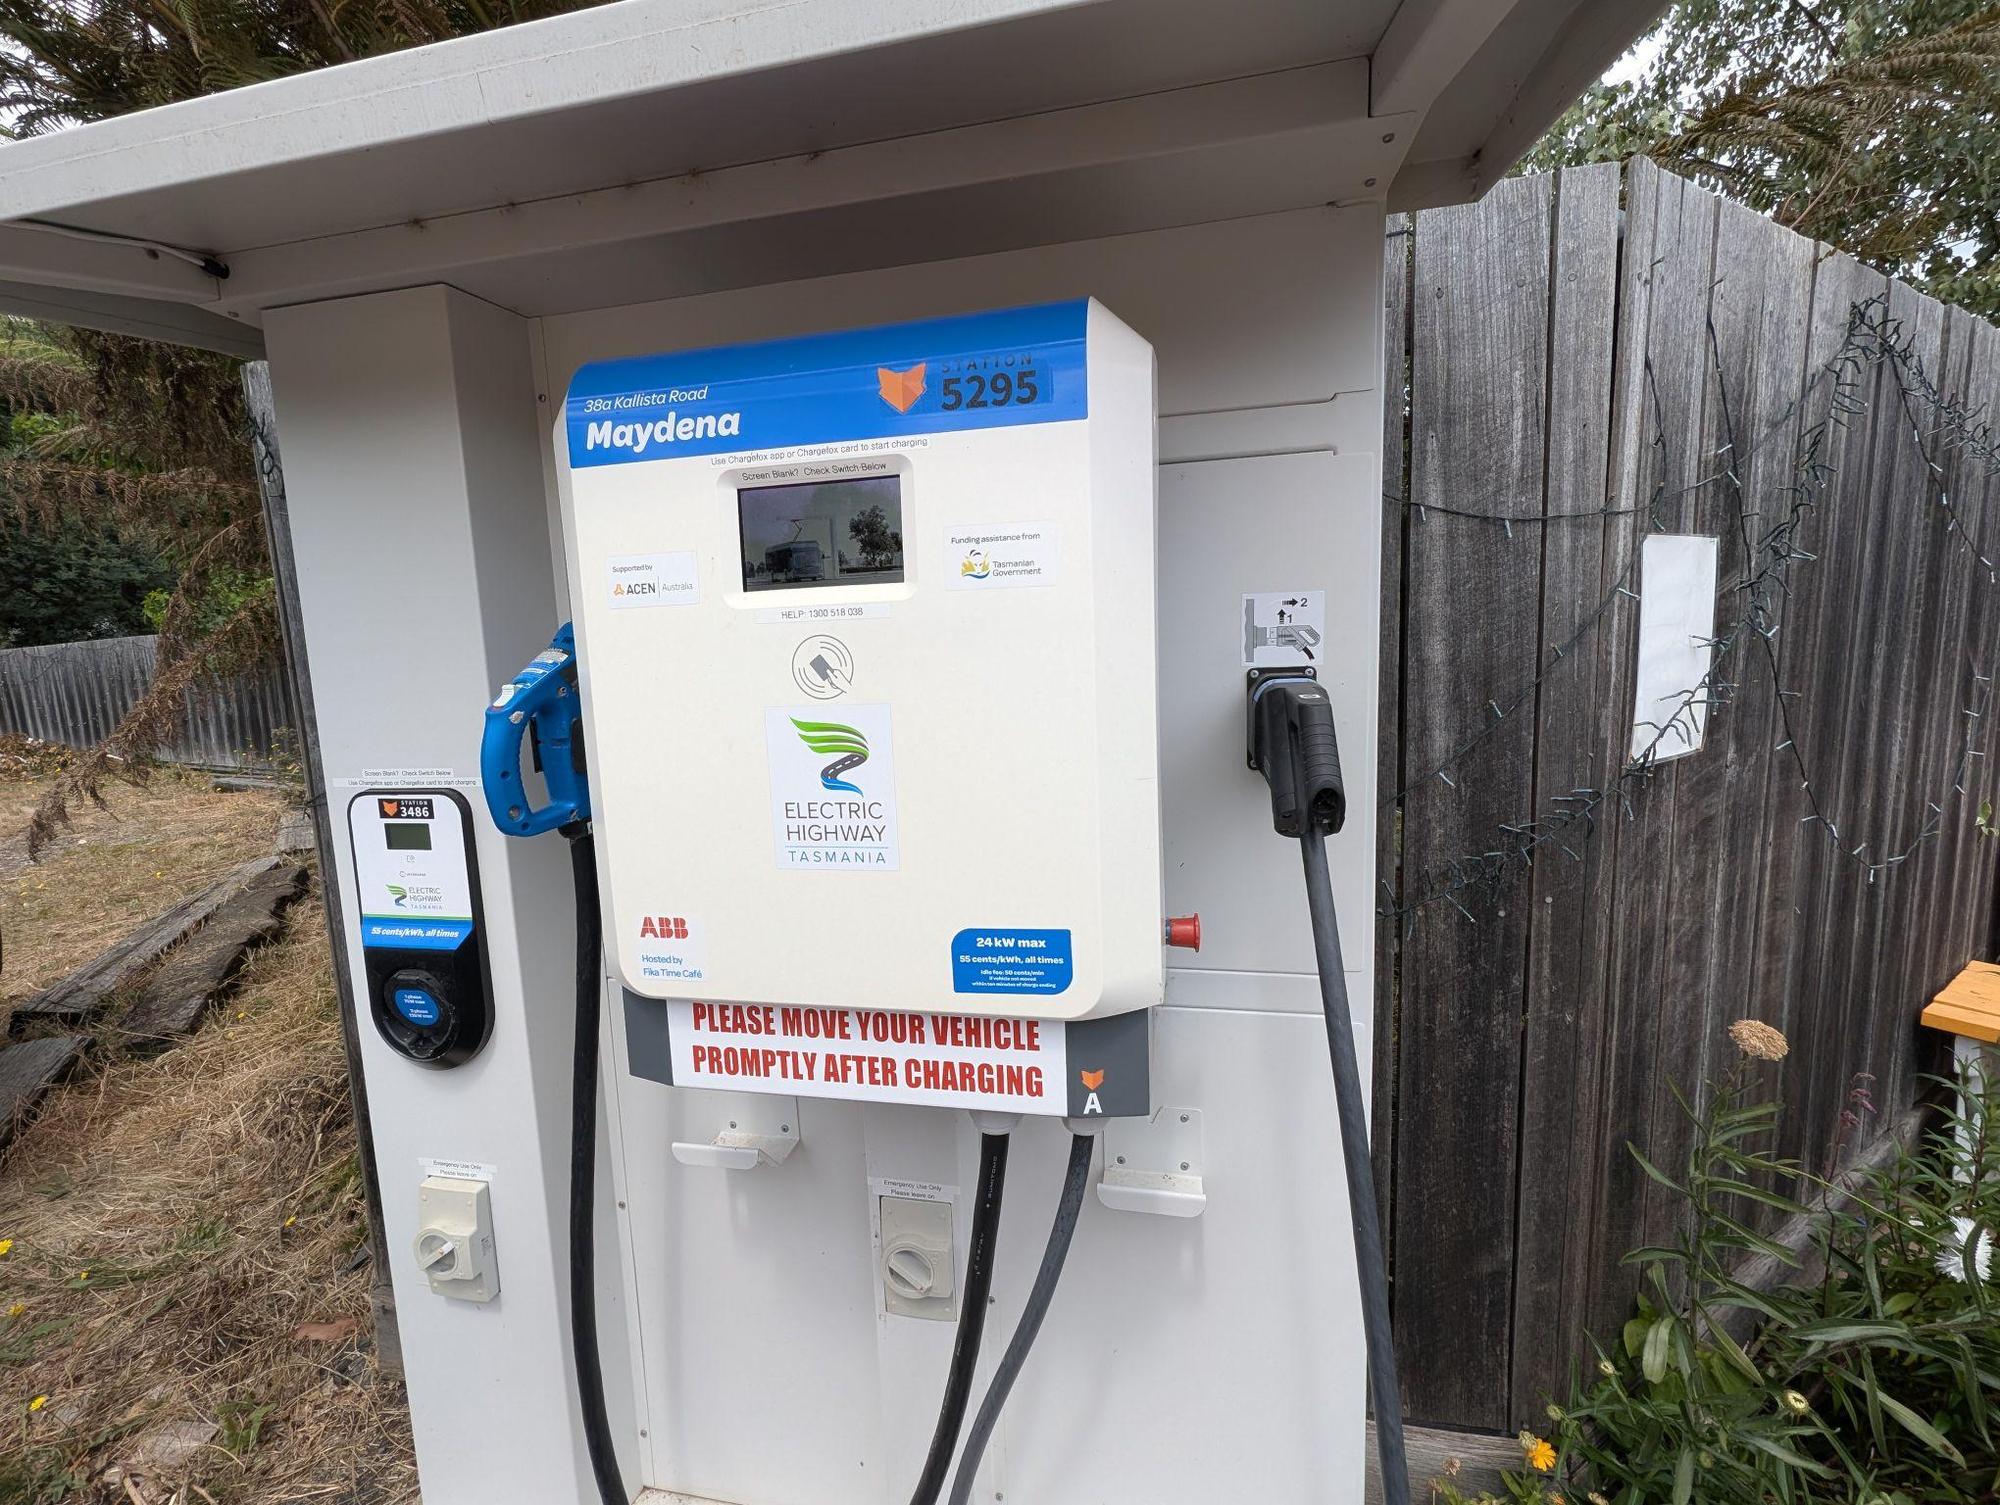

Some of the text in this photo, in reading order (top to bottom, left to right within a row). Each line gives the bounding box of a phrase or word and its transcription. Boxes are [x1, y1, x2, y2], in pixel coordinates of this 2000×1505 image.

[942, 354, 1033, 373] STATION
[941, 369, 1038, 411] 5295
[584, 385, 709, 413] 38a Kallista Road
[586, 411, 740, 453] Maydena
[711, 457, 726, 466] Use
[728, 453, 767, 464] Chargefox
[770, 452, 784, 460] app
[797, 447, 839, 458] Chargefox
[840, 444, 859, 453] card
[861, 443, 869, 451] to
[871, 441, 889, 451] start
[891, 438, 928, 449] charging
[742, 462, 886, 481] Screen Blank? Check Switch Below
[951, 536, 980, 544] Funding
[981, 534, 1021, 543] assistance
[612, 564, 644, 574] Supported
[992, 560, 1034, 568] Tasmanian
[992, 568, 1041, 577] Government
[626, 582, 693, 595] ACEN Australia
[1301, 598, 1308, 607] 2
[781, 609, 806, 619] HELP:
[809, 608, 828, 618] 1300
[1287, 614, 1293, 623] 1
[400, 806, 429, 817] 3486
[784, 802, 883, 819] ELECTRIC
[786, 824, 886, 842] HIGHWAY
[788, 850, 886, 864] TASMANIA
[409, 887, 440, 895] ELECTRIC
[371, 927, 381, 935] 55
[425, 929, 435, 937] all
[435, 929, 459, 938] times
[640, 917, 688, 939] ABB
[976, 937, 1046, 948] 24 kW max
[641, 954, 683, 965] Hosted by
[959, 955, 1064, 965] 55 cents/kWh, all times
[643, 967, 703, 978] Fika Time Café
[692, 1003, 1040, 1051] PLEASE MOVE YOUR VEHICLE
[692, 1045, 1044, 1097] PROMPTLY AFTER CHARGING
[1083, 1093, 1103, 1114] A
[883, 1180, 915, 1189] Emergency
